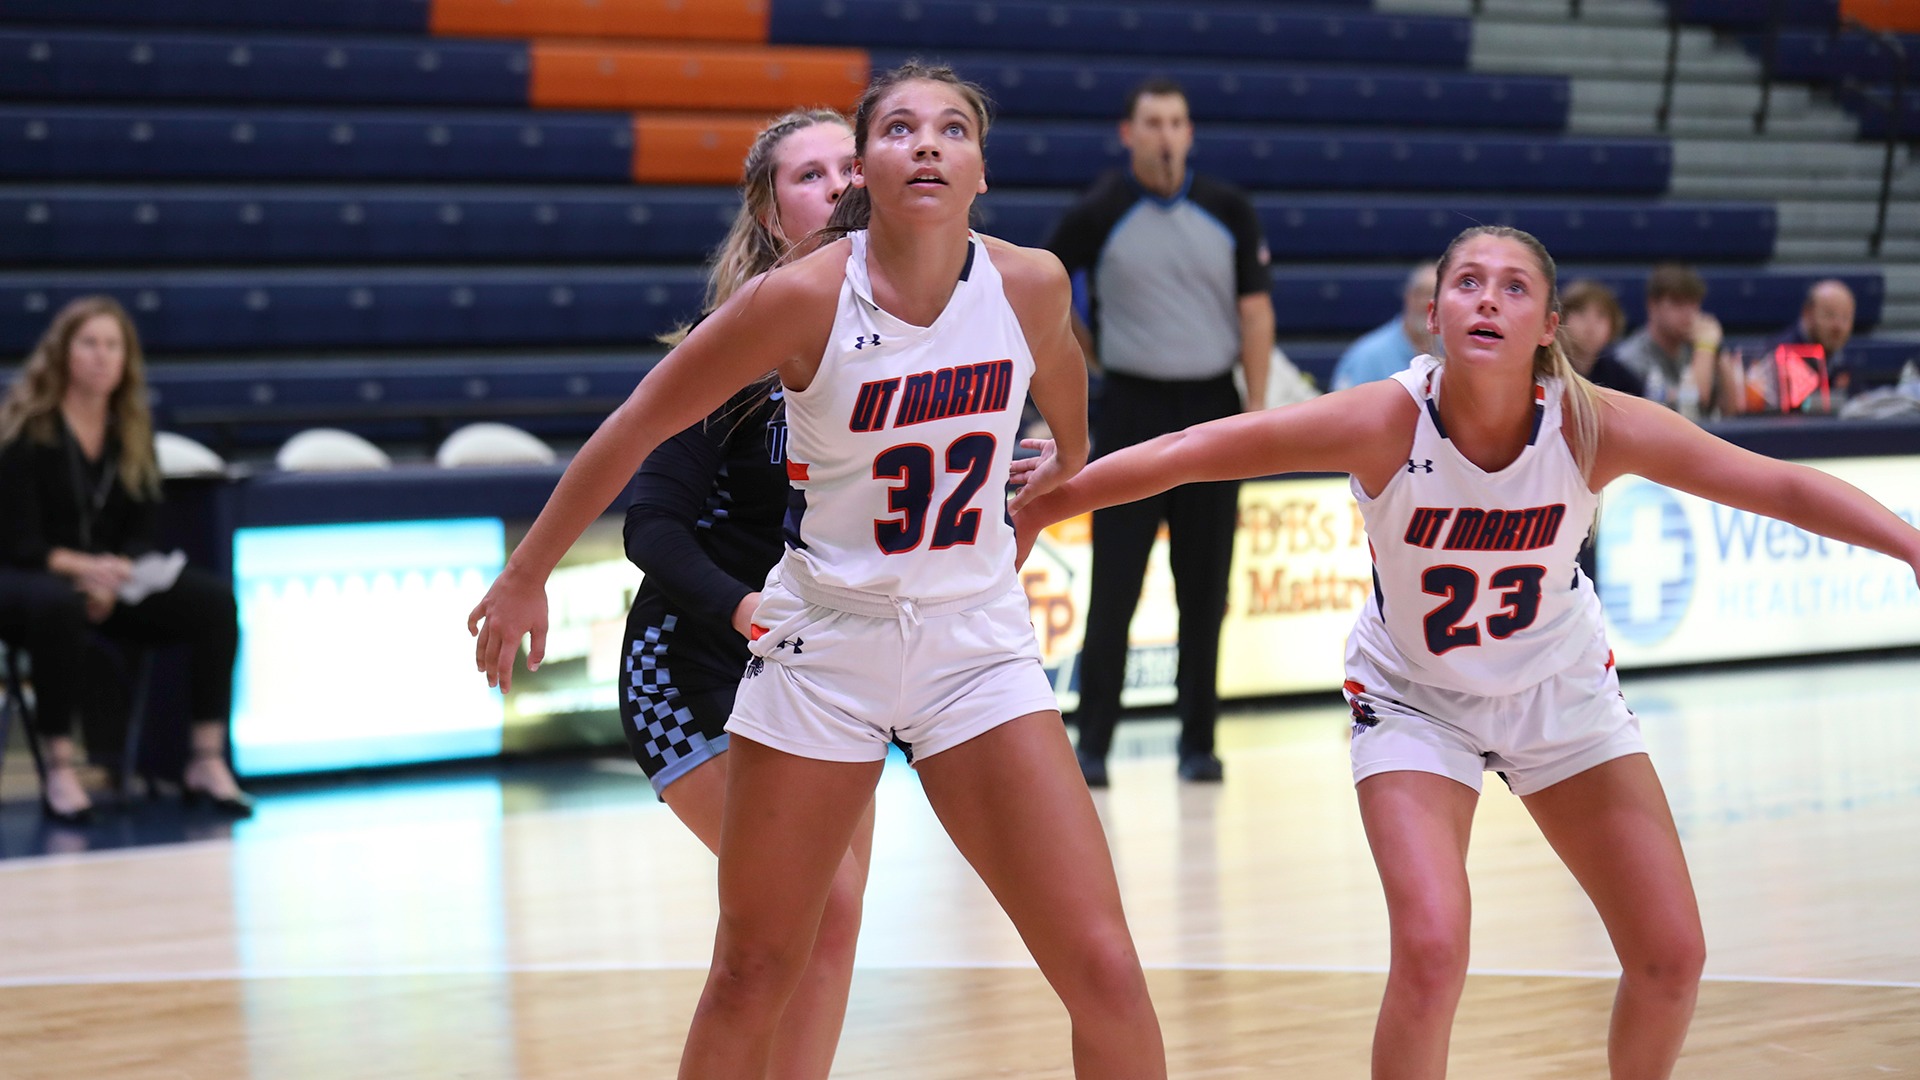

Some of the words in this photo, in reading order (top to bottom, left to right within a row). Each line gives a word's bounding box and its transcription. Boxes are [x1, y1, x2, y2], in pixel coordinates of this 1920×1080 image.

[849, 377, 902, 432] UT
[893, 359, 1013, 428] MARTIN
[873, 431, 997, 555] 32
[1404, 507, 1454, 549] UT
[1442, 503, 1566, 551] MARTIN
[1421, 564, 1548, 656] 23
